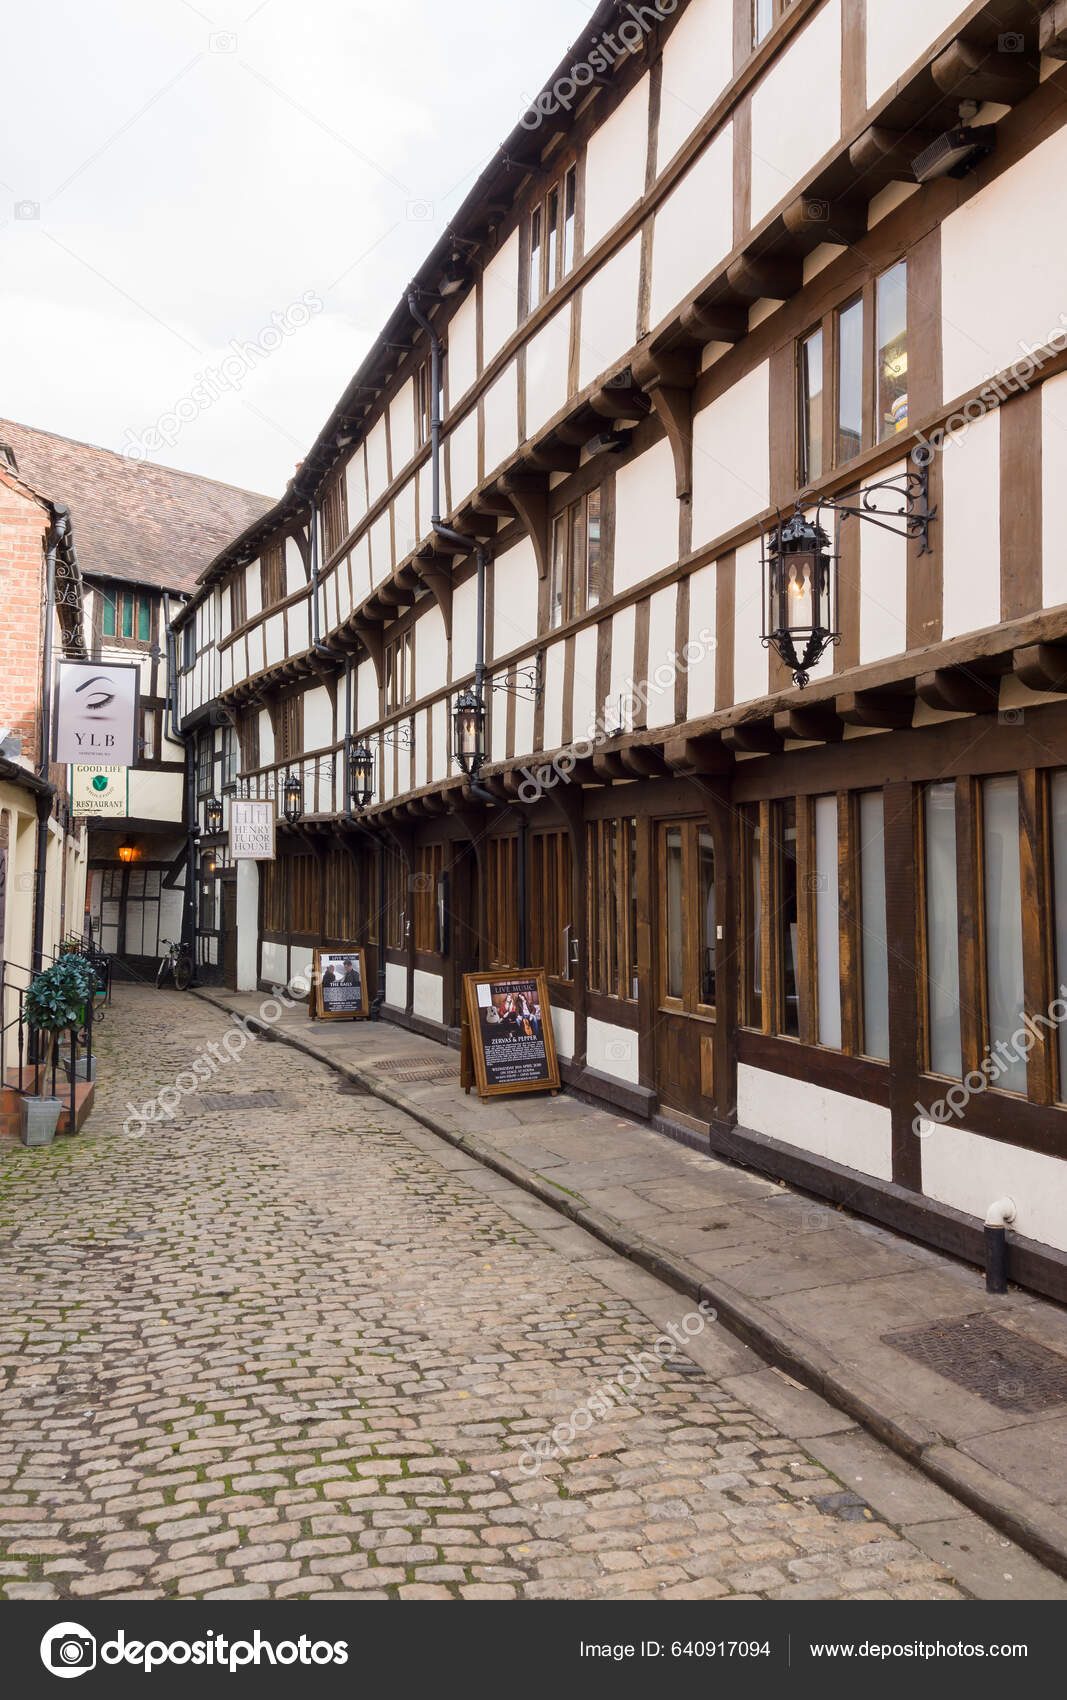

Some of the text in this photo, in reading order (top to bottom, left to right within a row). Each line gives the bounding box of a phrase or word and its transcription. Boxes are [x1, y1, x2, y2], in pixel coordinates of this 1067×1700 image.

[77, 765, 102, 773] GOOD
[76, 800, 122, 809] RESTAURANT
[234, 825, 271, 834] HENRY
[234, 834, 270, 842] TUDOR
[234, 842, 271, 851] HOUSE
[512, 984, 535, 992] MUSIC
